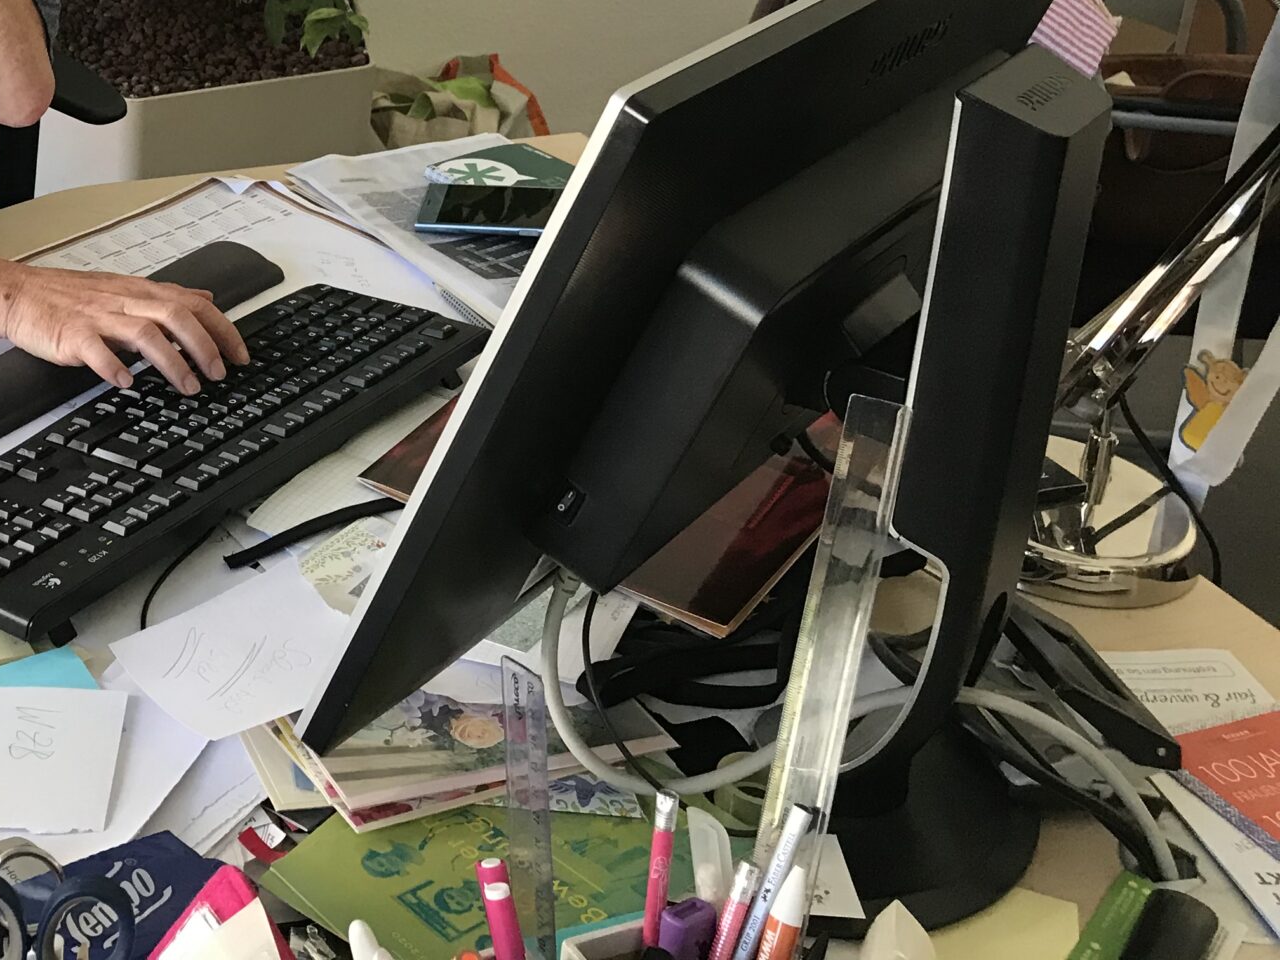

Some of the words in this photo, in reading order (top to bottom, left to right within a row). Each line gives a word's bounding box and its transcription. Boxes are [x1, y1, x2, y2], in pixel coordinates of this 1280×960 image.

[88, 549, 108, 563] K120
[1135, 691, 1200, 705] unverp
[1220, 688, 1257, 706] fair
[1198, 757, 1258, 785] 100
[1247, 747, 1280, 778] JA
[740, 933, 753, 952] GRIP
[748, 915, 760, 933] 2001
